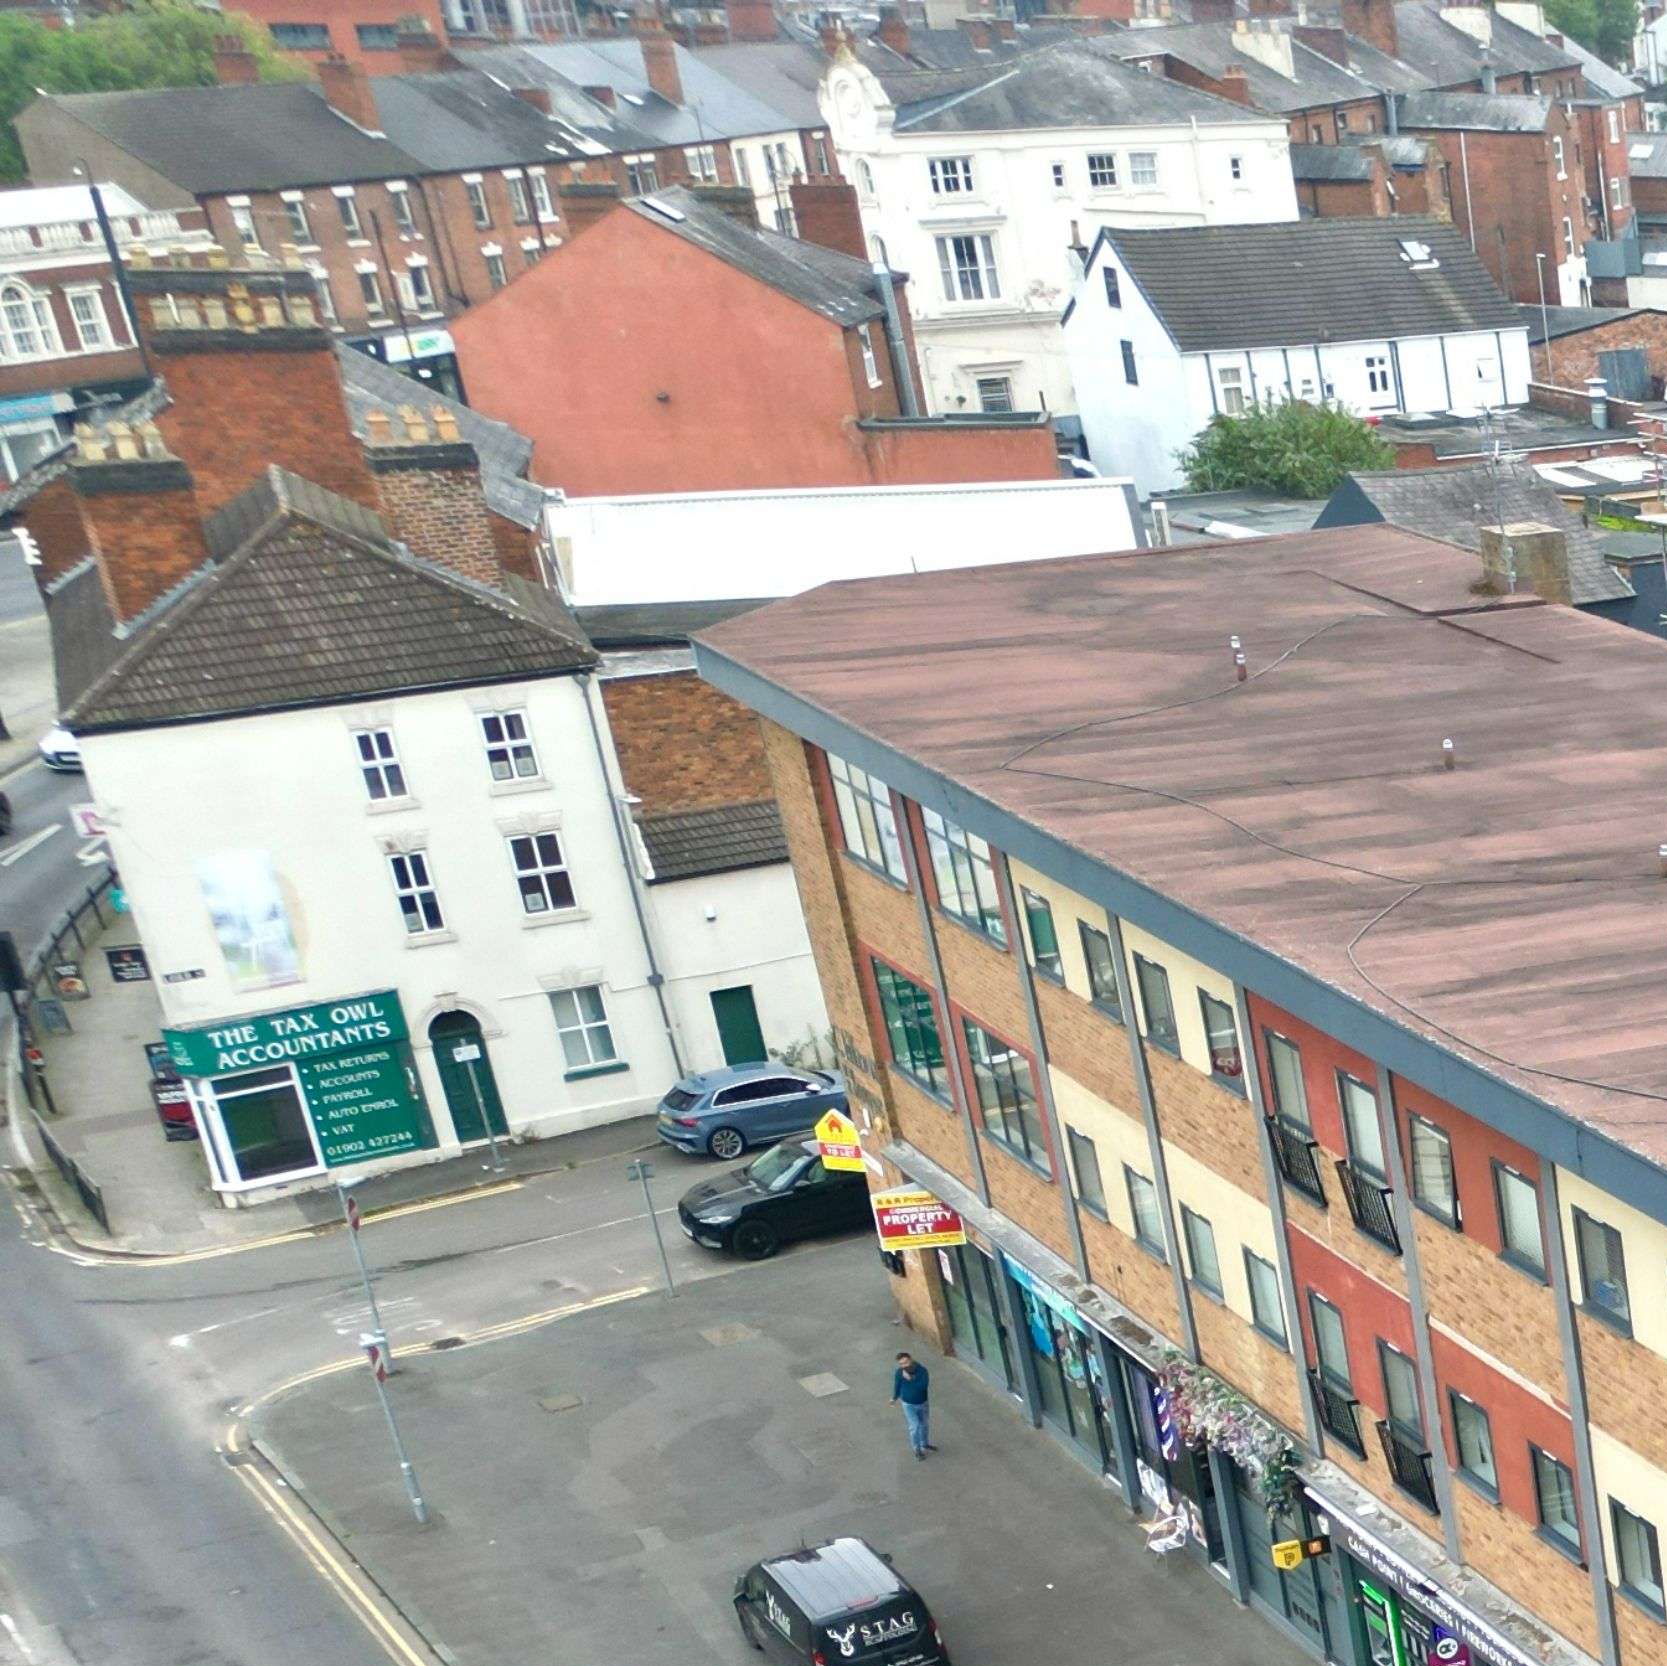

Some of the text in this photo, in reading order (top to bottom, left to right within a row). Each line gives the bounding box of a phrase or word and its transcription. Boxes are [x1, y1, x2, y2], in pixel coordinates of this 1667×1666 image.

[208, 1001, 384, 1049] THE TAX OWL
[218, 1021, 392, 1071] ACCOUNTANTS
[313, 1050, 390, 1074] TAX RETURNS
[319, 1070, 381, 1089] ACCOUNTS
[323, 1087, 373, 1105] PAYROLL
[328, 1098, 399, 1121] AUTO ENROL
[331, 1123, 356, 1136] VAT
[326, 1140, 366, 1157] 01902
[882, 1210, 952, 1226] PROPERTY
[907, 1223, 934, 1236] LET
[859, 1610, 915, 1640] STAG
